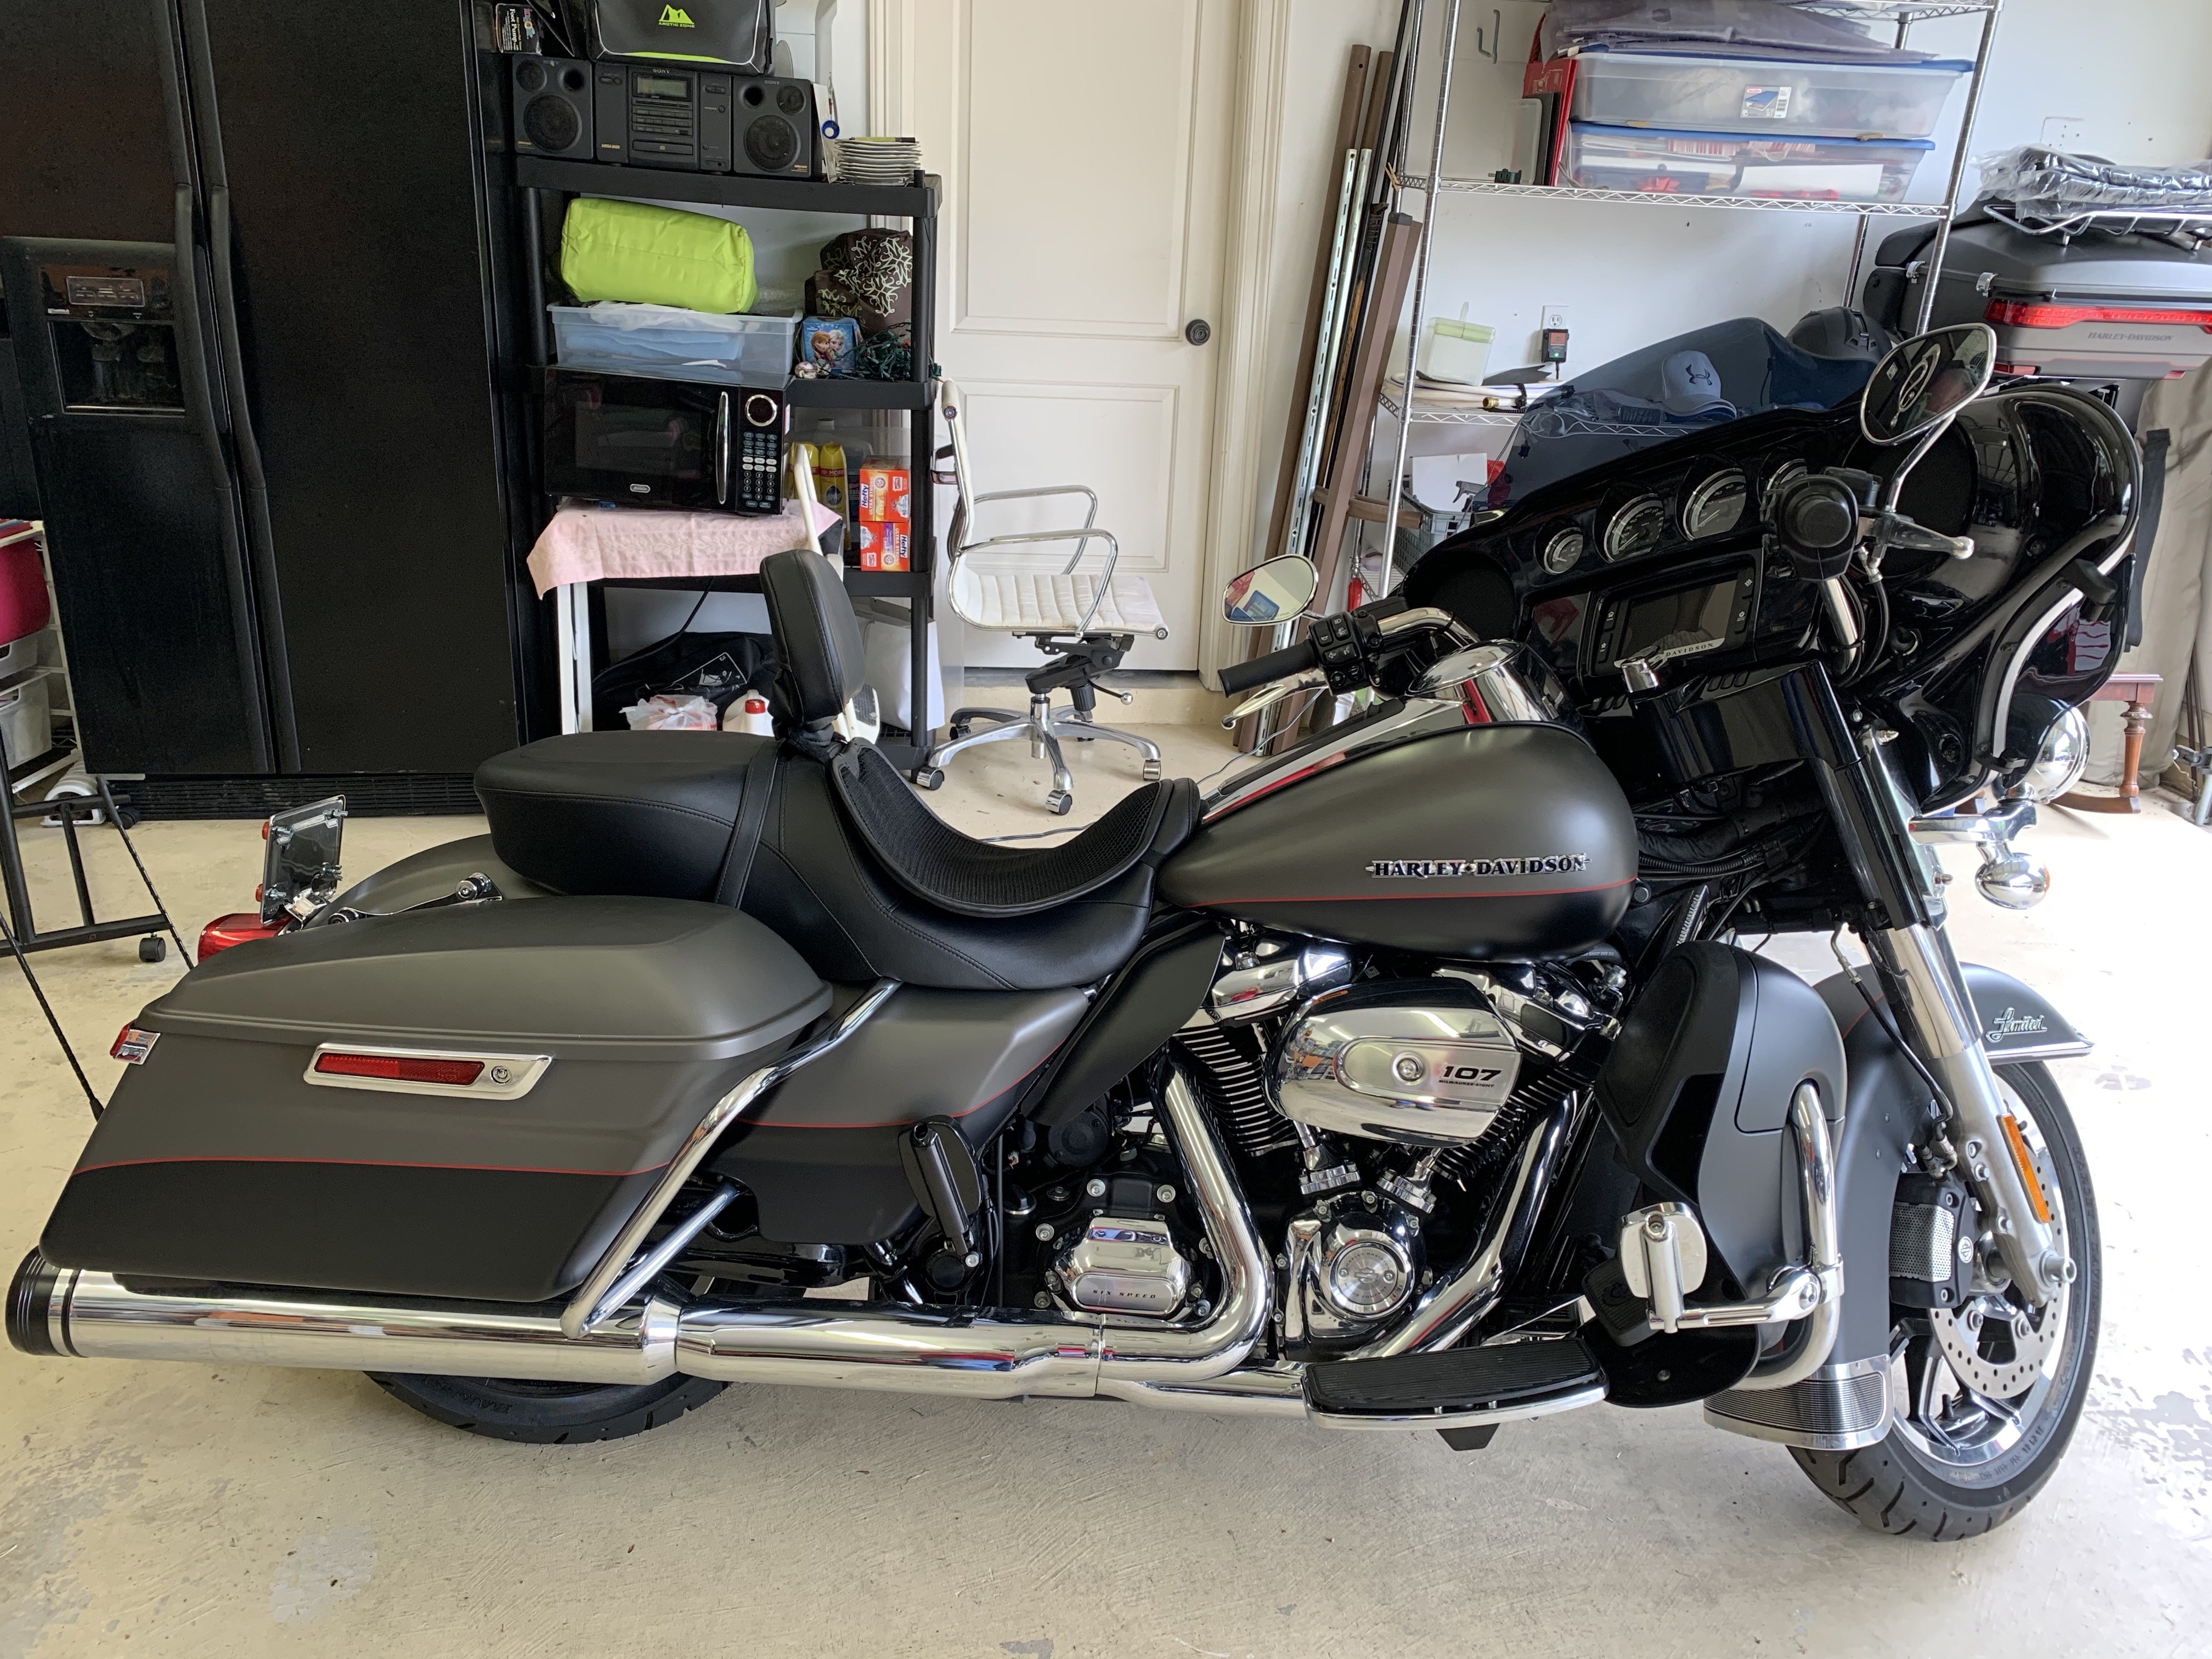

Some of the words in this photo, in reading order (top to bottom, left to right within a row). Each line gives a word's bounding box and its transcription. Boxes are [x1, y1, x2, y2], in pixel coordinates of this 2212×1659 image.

[2087, 332, 2174, 341] HARLEY-DAVIDSON
[1666, 642, 1714, 657] DAVIDSON
[1985, 1007, 2047, 1043] Limited
[1441, 1065, 1503, 1081] 107
[1438, 1079, 1496, 1088] MILWAUKEE-EIGHT
